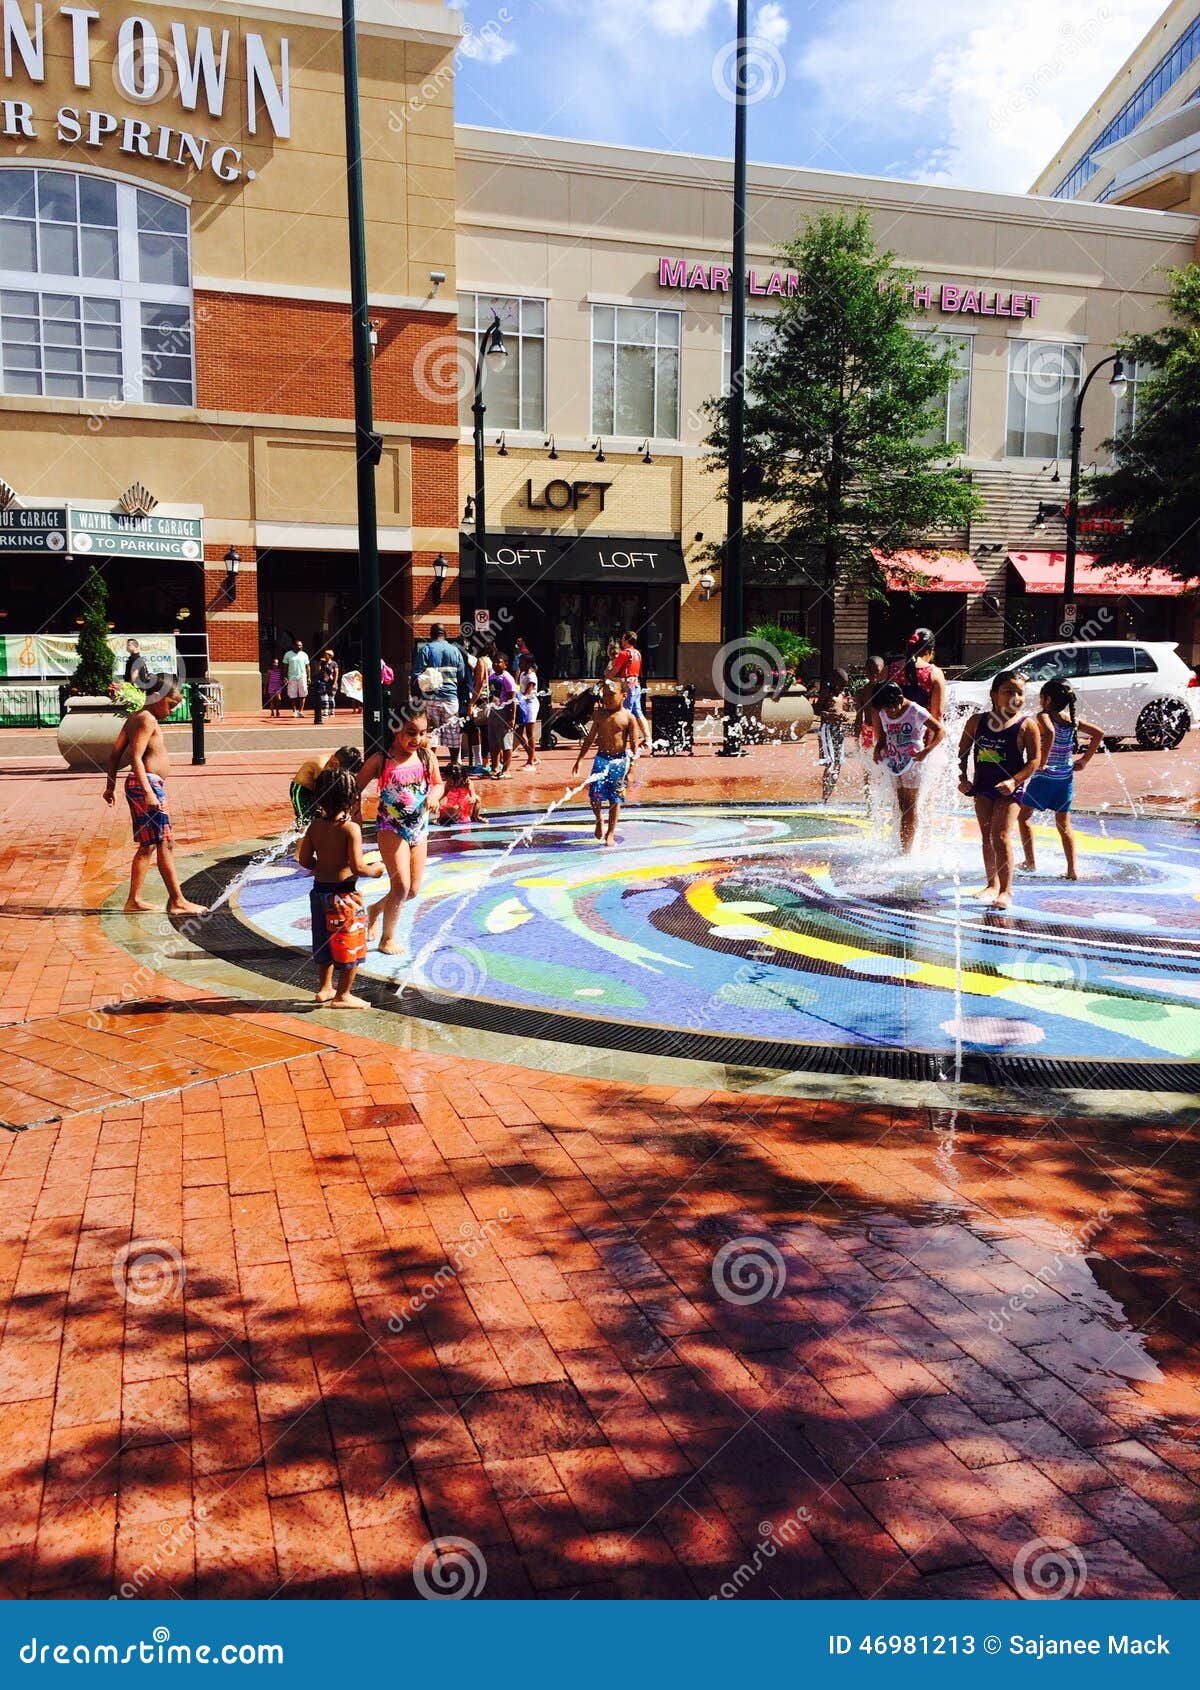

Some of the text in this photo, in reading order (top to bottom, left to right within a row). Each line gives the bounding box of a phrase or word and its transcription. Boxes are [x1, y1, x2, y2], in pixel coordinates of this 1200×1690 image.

[3, 0, 291, 138] NTOWN
[56, 106, 257, 182] SPRING.
[659, 257, 803, 298] MARLAN
[940, 284, 1041, 319] BALLET
[527, 478, 613, 511] LOFT
[20, 511, 59, 527] GARAGE
[79, 512, 195, 536] WAYNE AVENUE GARAGE
[96, 538, 180, 553] TO PARKING
[484, 549, 546, 566] LOFT
[598, 551, 658, 569] LOFT
